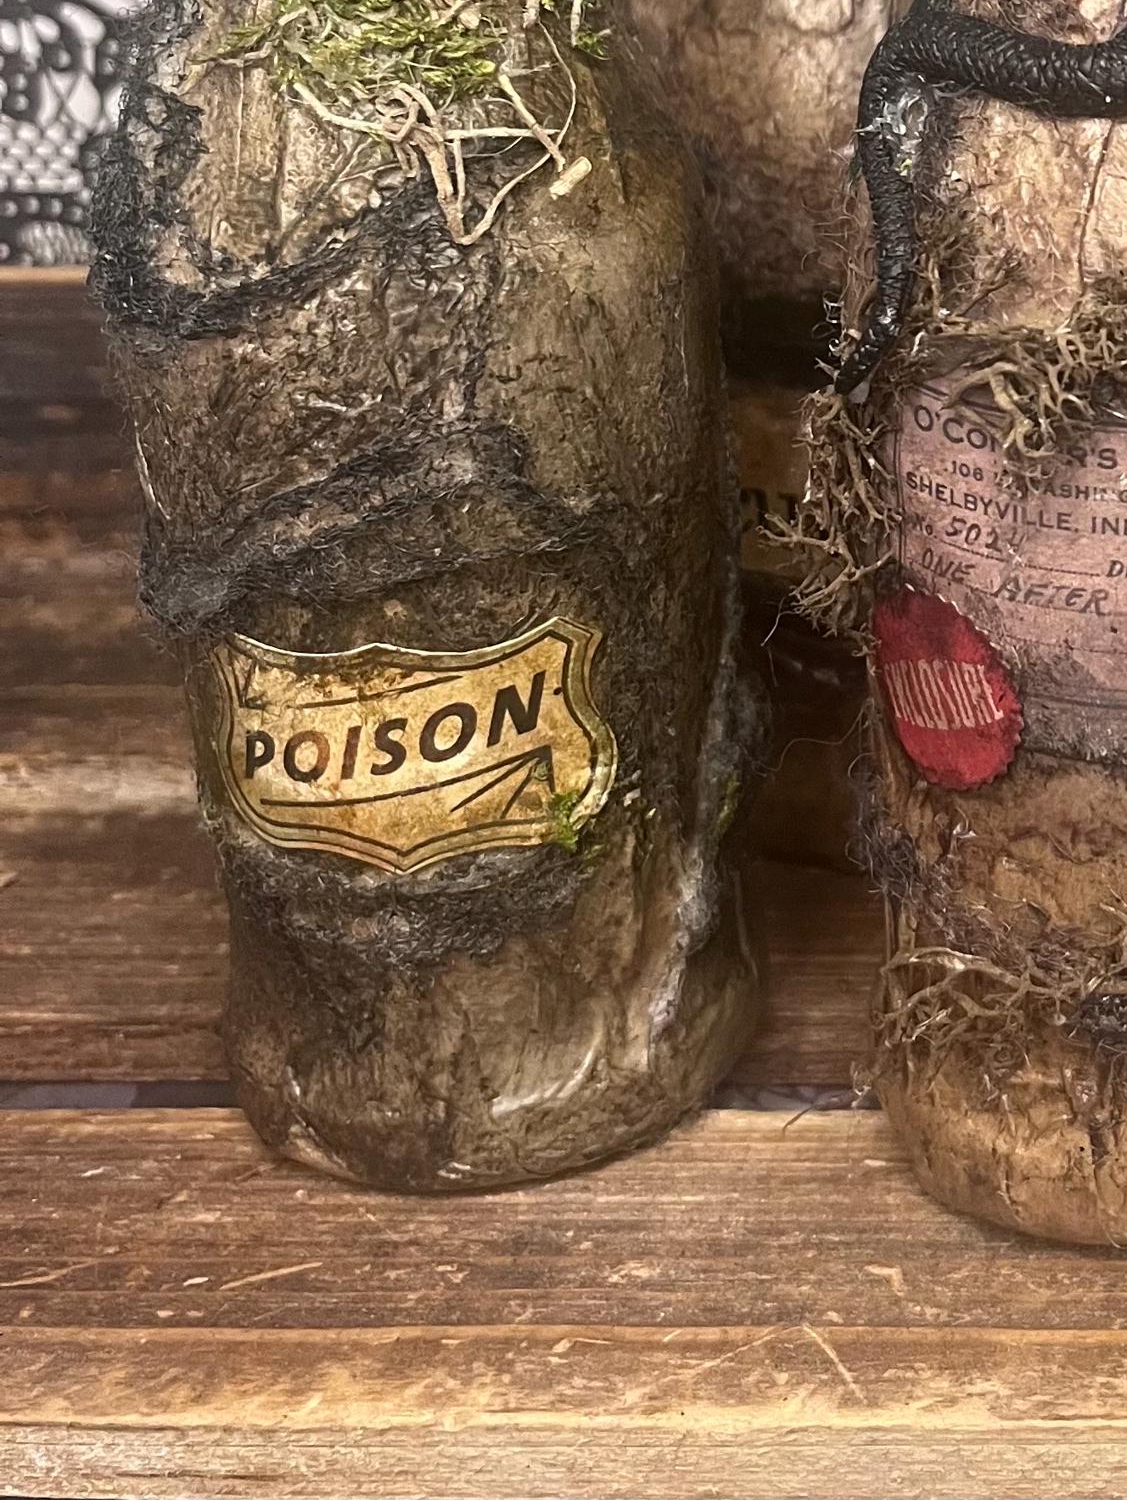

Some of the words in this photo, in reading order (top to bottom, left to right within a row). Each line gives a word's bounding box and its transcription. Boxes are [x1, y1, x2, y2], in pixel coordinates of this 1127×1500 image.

[950, 460, 985, 482] 106
[921, 547, 976, 585] ONE
[883, 658, 1004, 731] ENCLOSURE
